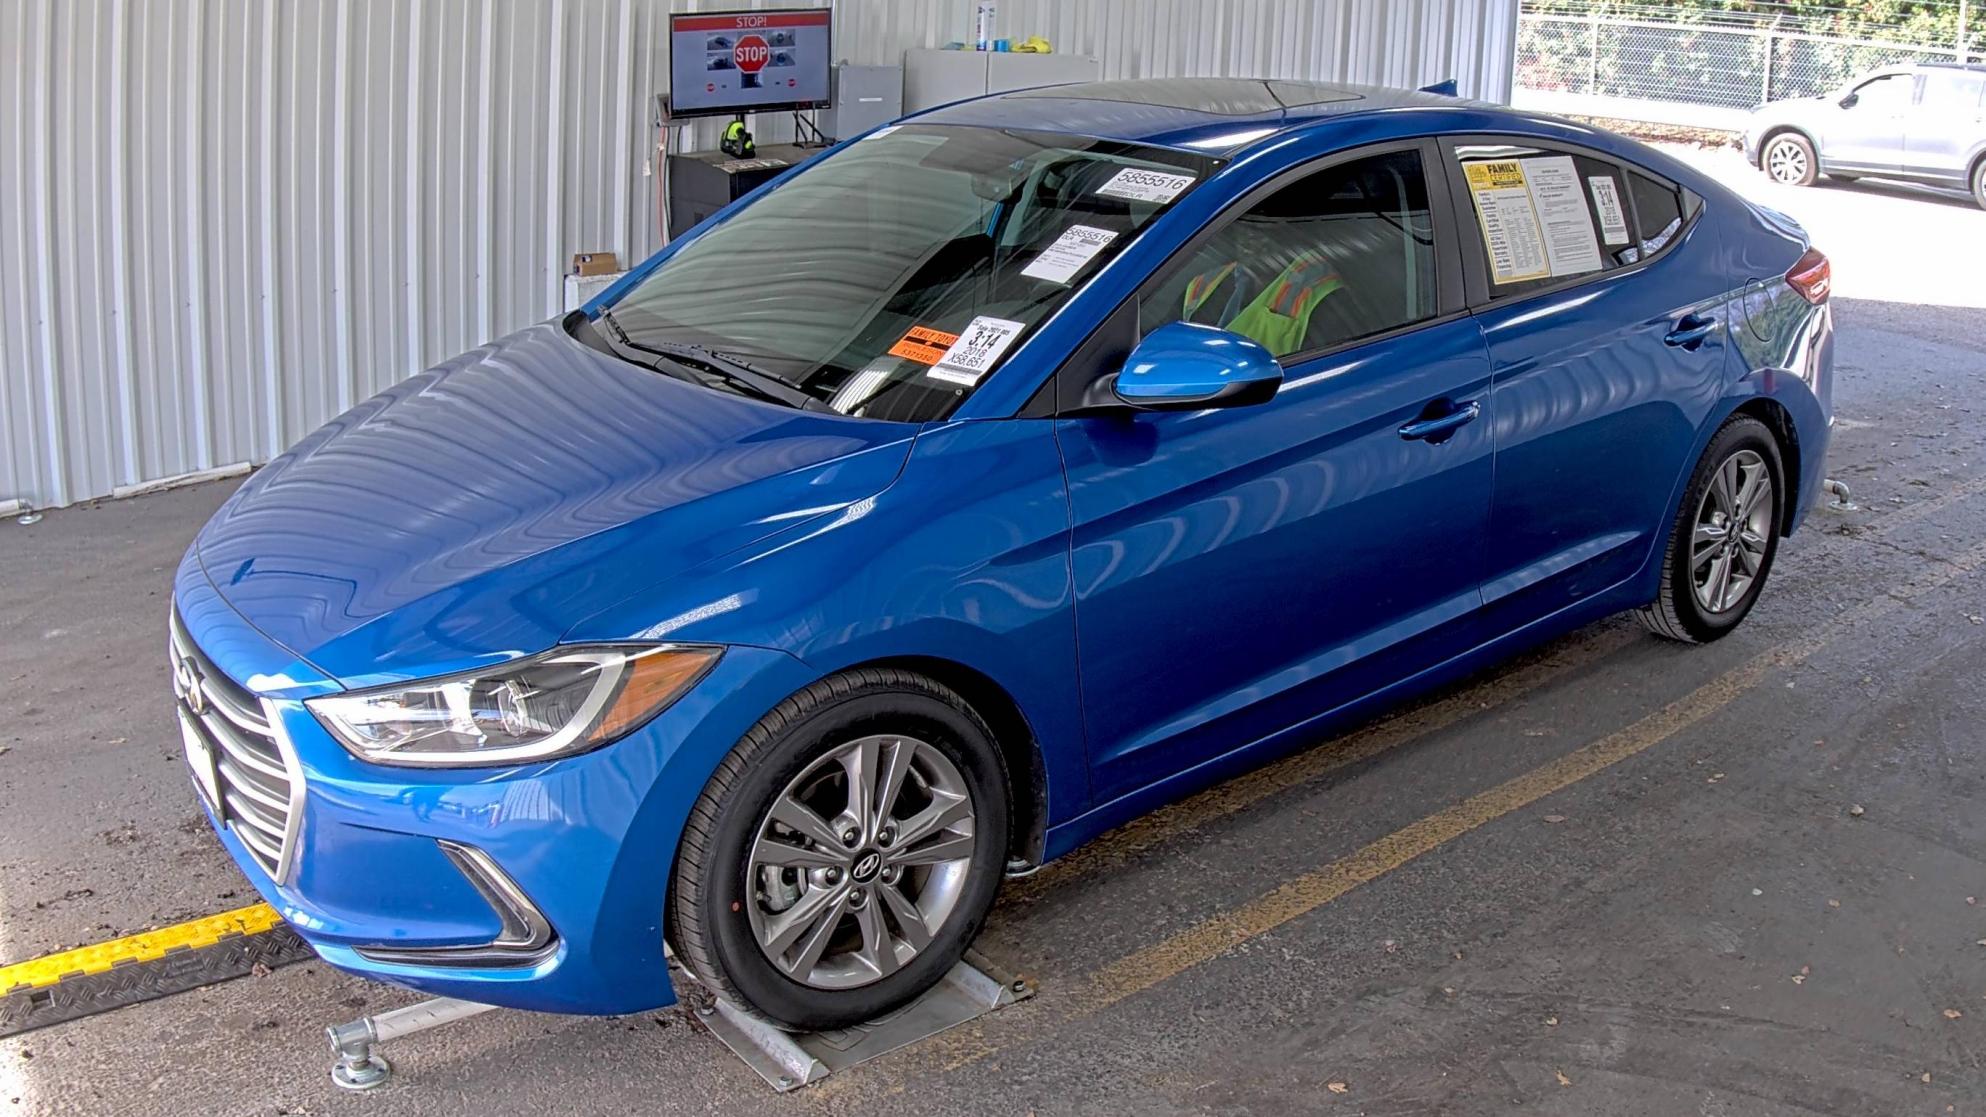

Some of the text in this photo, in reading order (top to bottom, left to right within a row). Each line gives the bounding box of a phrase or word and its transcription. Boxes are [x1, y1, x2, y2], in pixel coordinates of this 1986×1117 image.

[736, 16, 767, 28] STOP!
[736, 47, 767, 62] STOP
[1487, 163, 1517, 174] FAMILY
[1117, 171, 1187, 190] 5855516
[1066, 227, 1113, 243] 5855516
[968, 331, 1001, 349] 3:14
[963, 346, 988, 358] 2018
